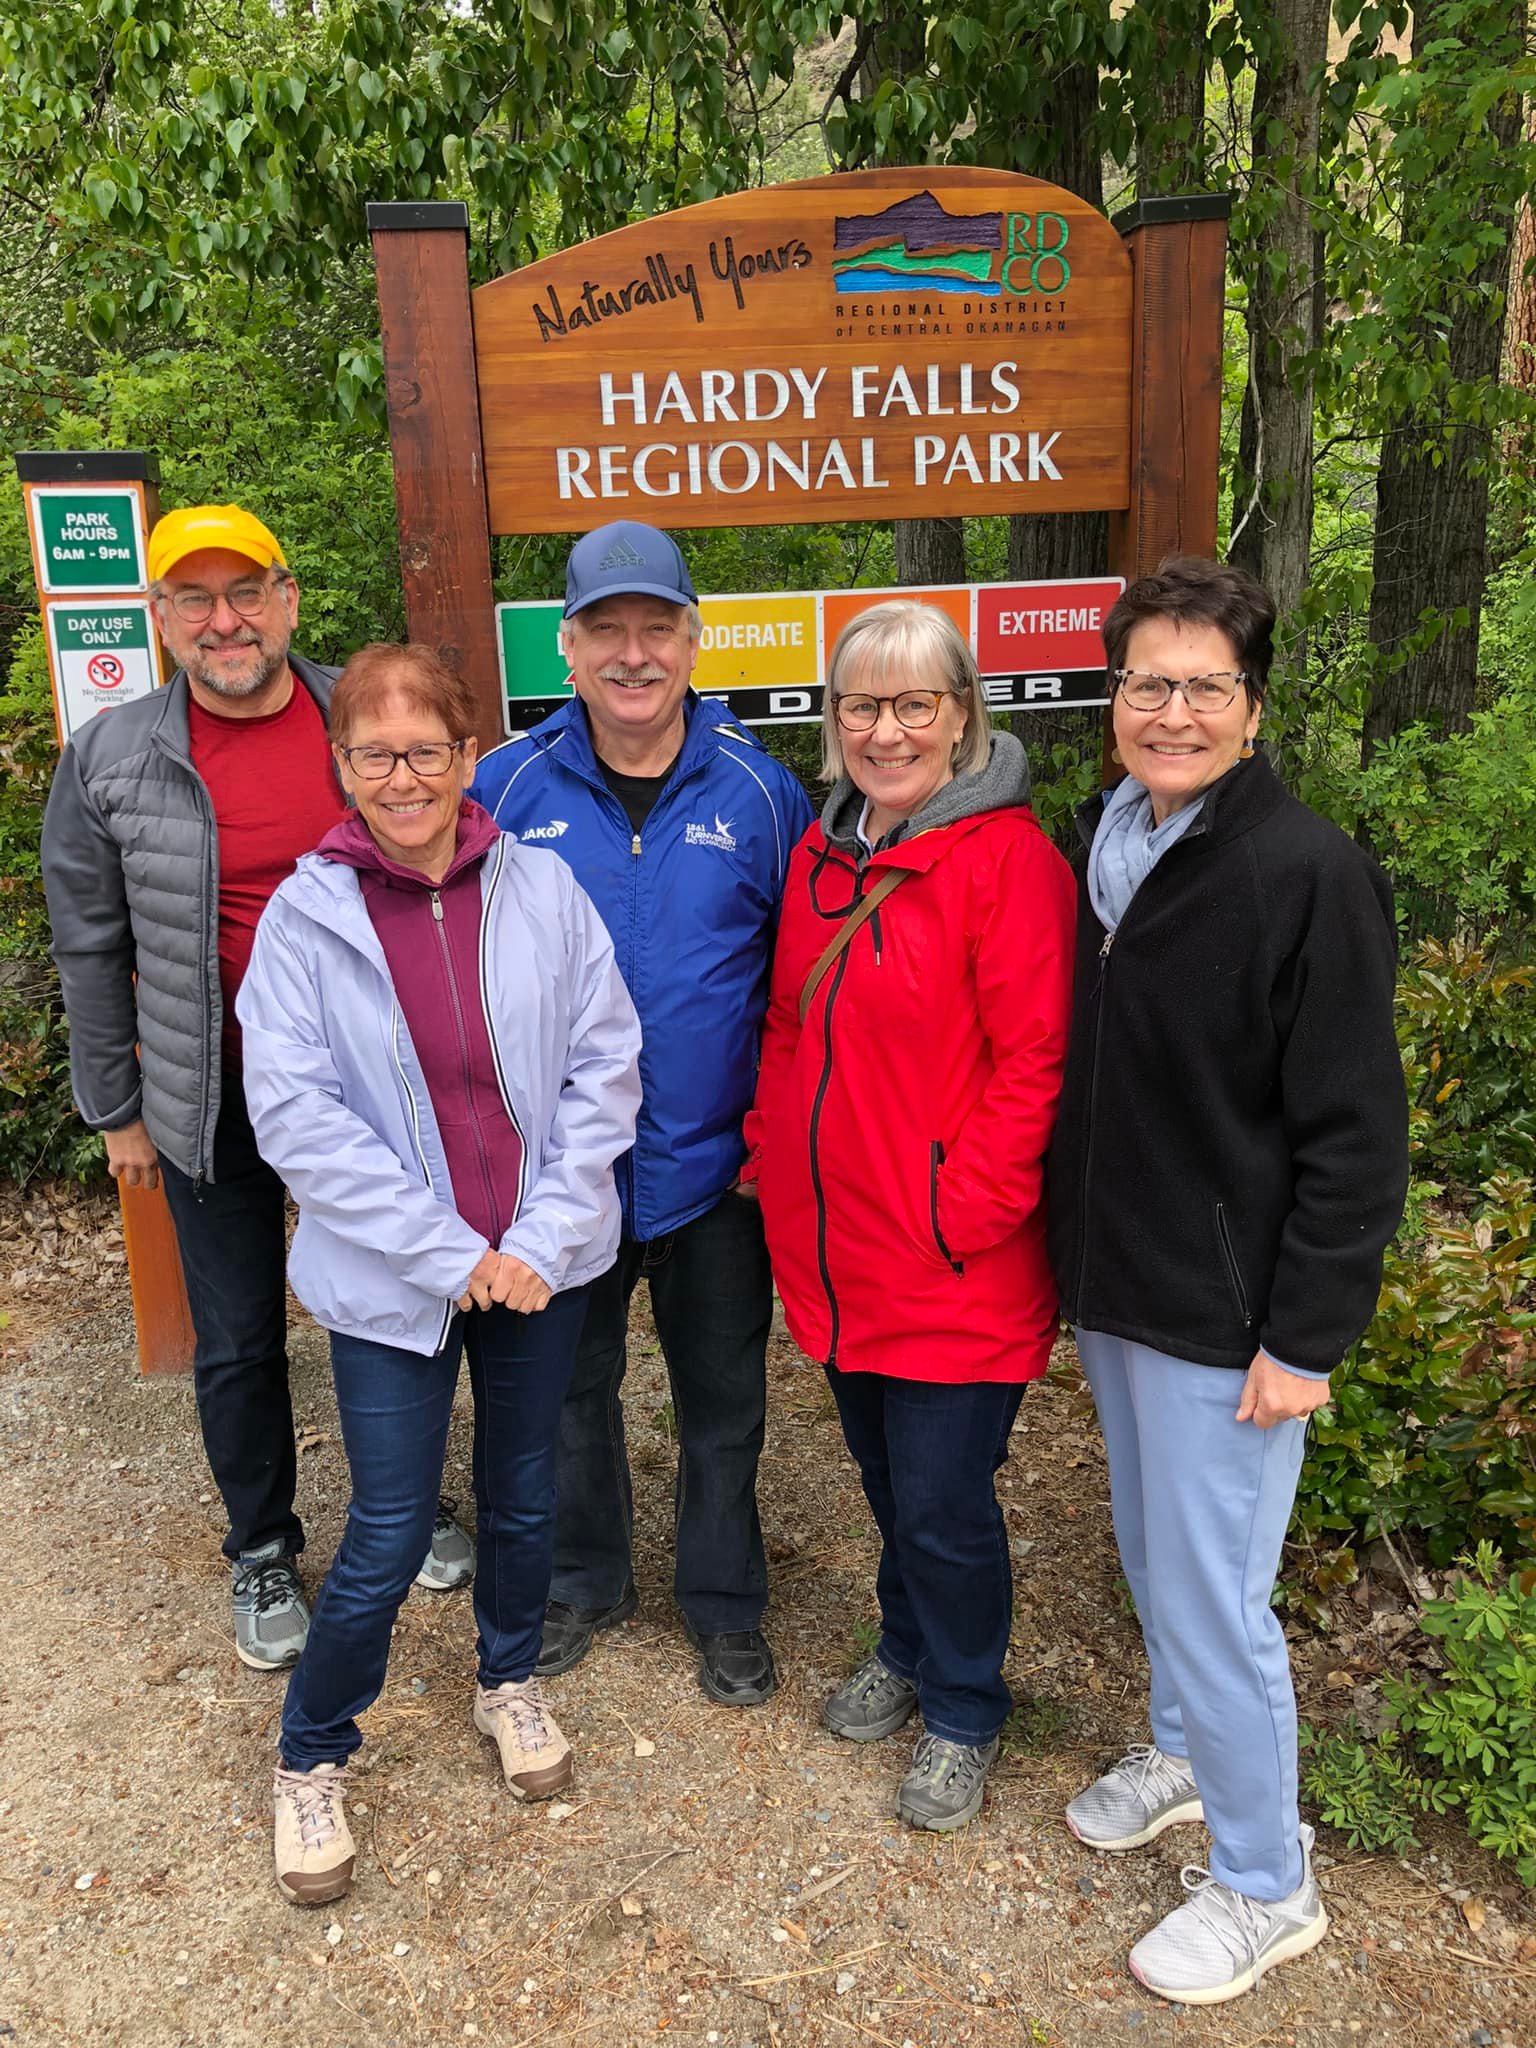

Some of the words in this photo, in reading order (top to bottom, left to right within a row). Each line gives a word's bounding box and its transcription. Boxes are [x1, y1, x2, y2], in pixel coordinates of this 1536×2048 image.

[532, 253, 705, 344] Naturally
[709, 236, 814, 310] Yours
[836, 303, 945, 317] REGIONAL
[963, 301, 1067, 315] DISTRICT
[836, 325, 853, 337] of
[867, 323, 953, 336] CENTRAL
[966, 320, 1067, 335] OKANAGAN
[599, 366, 828, 426] HARDY
[851, 361, 1021, 418] FALLS
[555, 437, 890, 499] REGIONAL
[914, 431, 1064, 486] PARK
[65, 513, 111, 526] PARK
[61, 527, 118, 541] HOURS
[52, 546, 85, 560] 6AM
[98, 546, 131, 559] 9PM
[67, 618, 98, 631] DAY
[102, 617, 134, 630] USE
[999, 607, 1101, 635] EXTREME
[81, 631, 122, 644] ONLY
[699, 621, 804, 650] ODERATE
[81, 688, 94, 696] No
[521, 826, 558, 841] JAKO
